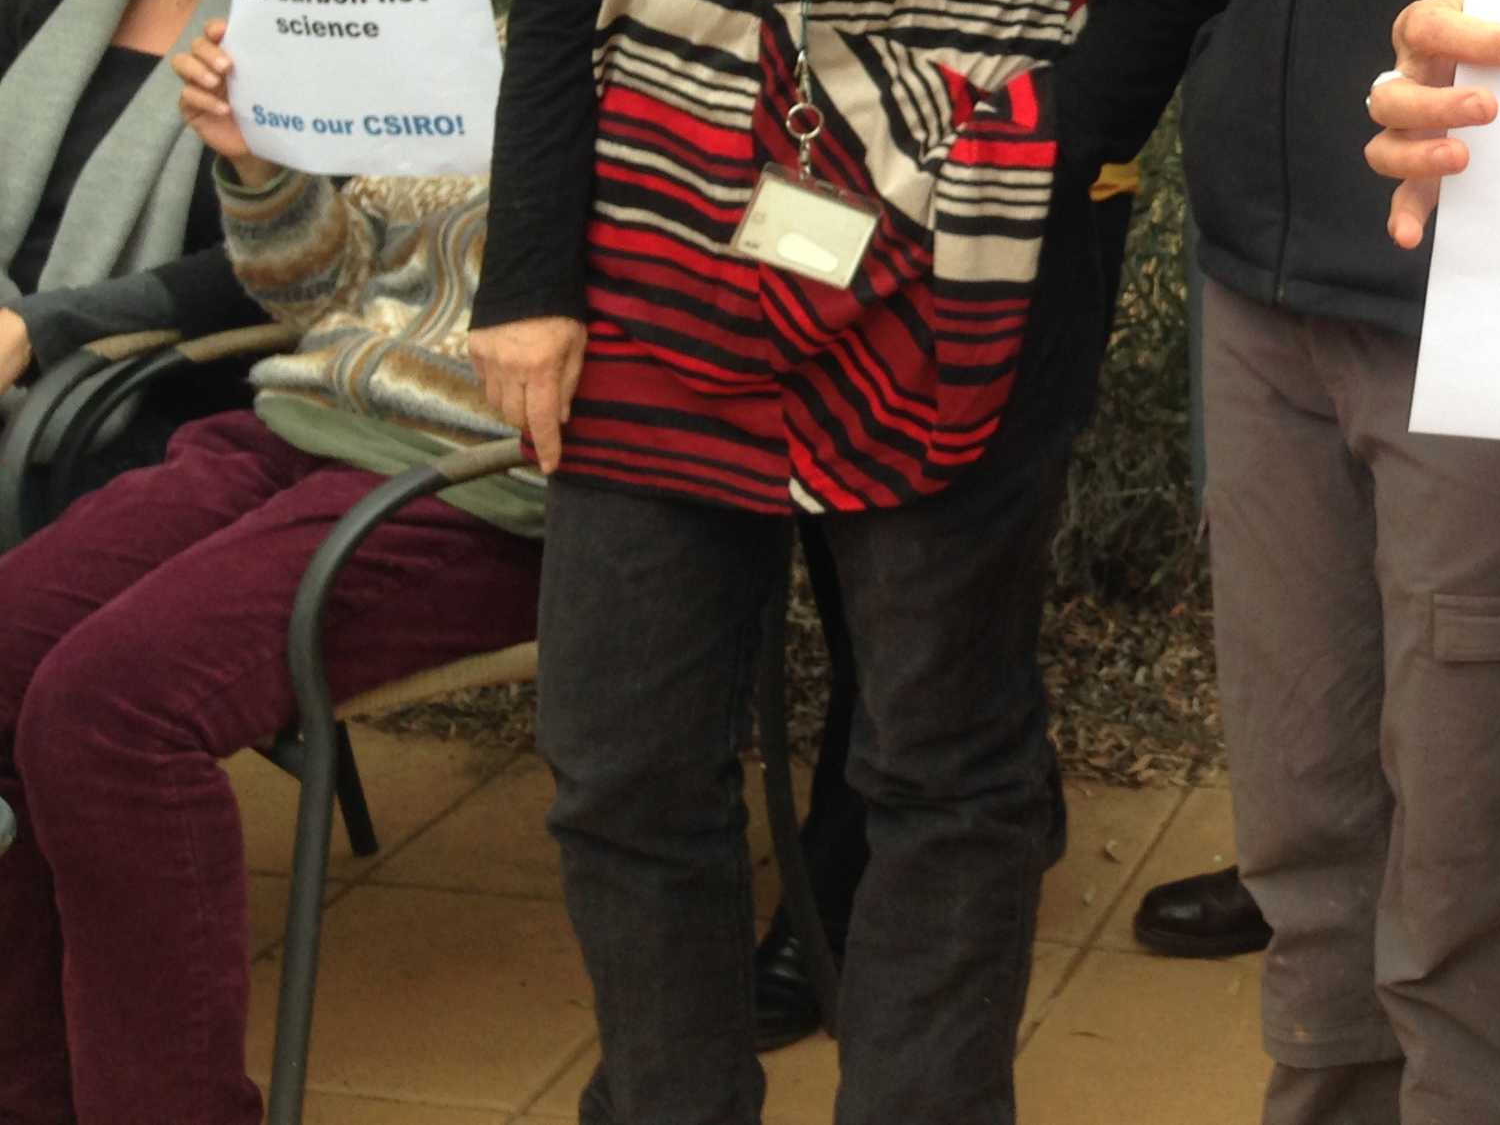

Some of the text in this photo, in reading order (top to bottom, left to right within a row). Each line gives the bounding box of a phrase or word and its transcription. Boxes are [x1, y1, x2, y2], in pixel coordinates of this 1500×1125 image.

[276, 15, 380, 38] science
[252, 104, 465, 136] Save our CSIRO!
